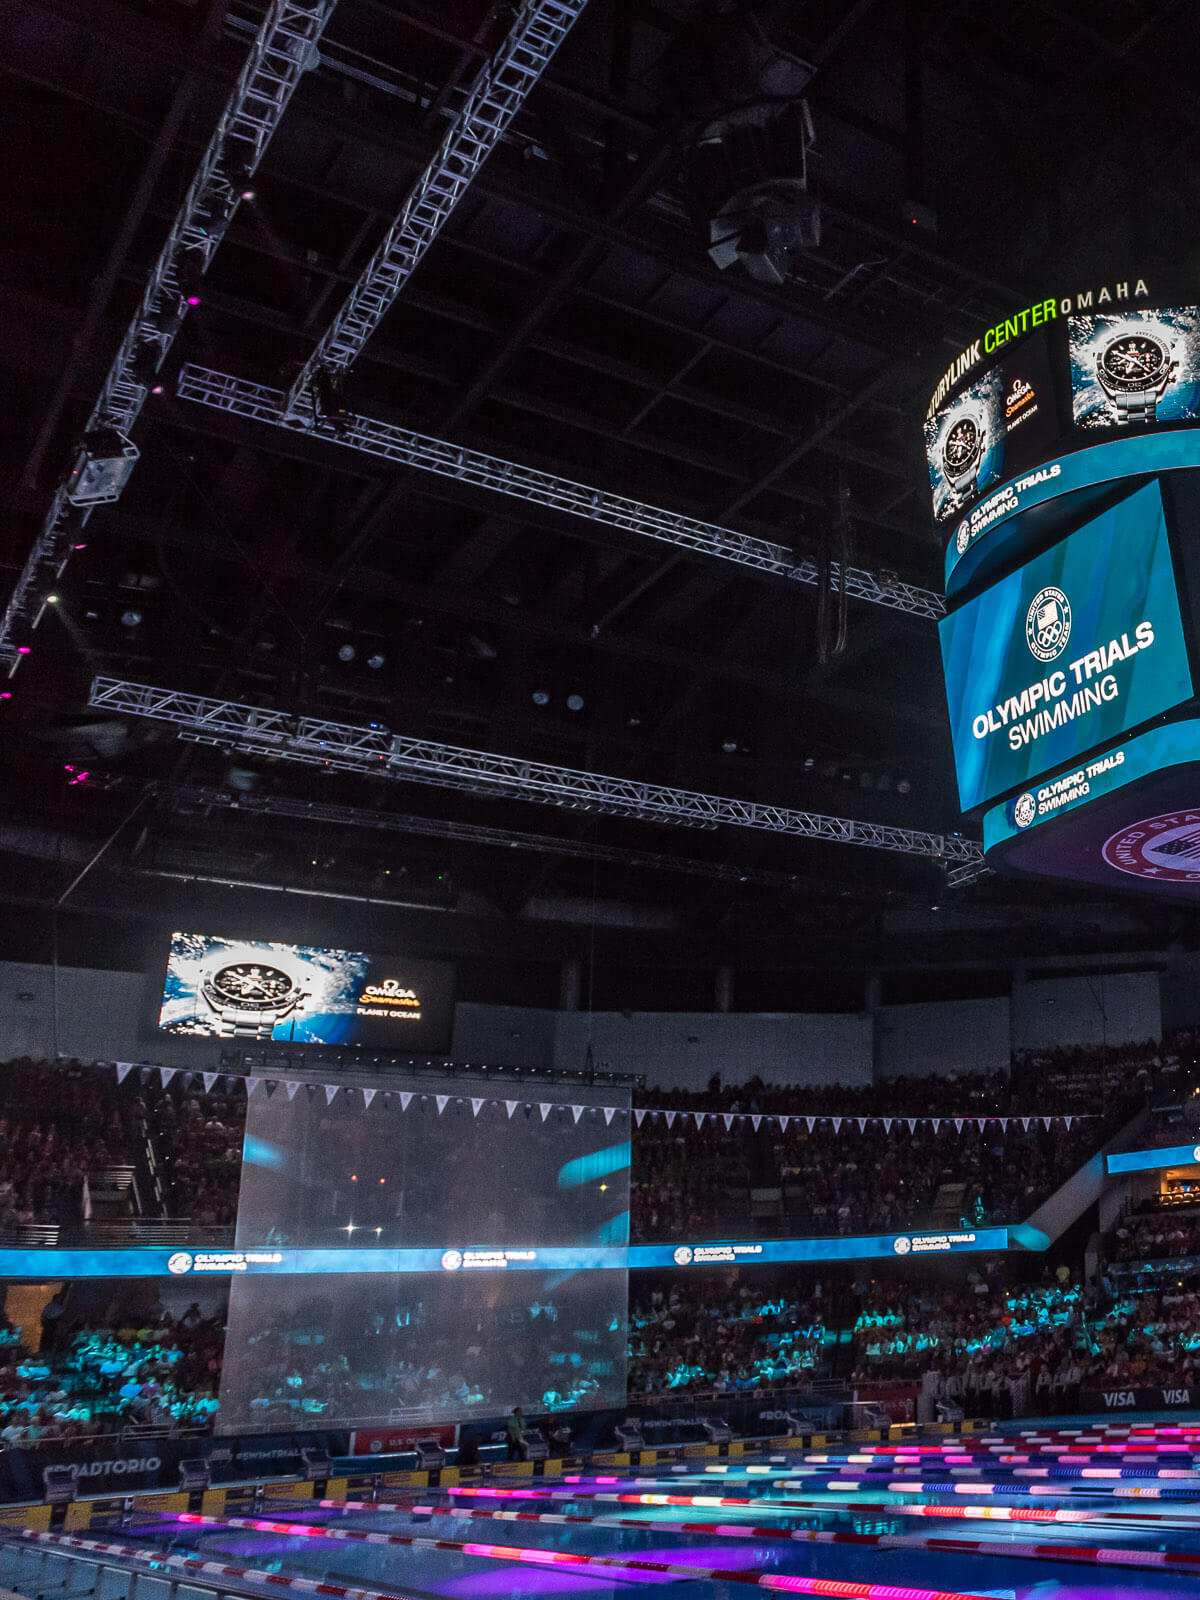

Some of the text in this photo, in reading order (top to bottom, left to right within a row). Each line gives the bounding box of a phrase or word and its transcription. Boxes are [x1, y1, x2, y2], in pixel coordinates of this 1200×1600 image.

[984, 298, 1057, 353] CENTER
[1061, 279, 1149, 314] OMAHA
[1007, 382, 1031, 405] OMEGA
[970, 464, 1062, 525] OLYMPIC TRIALS
[970, 497, 1019, 537] SWIMMING
[972, 621, 1155, 739] OLYMPIC TRIALS
[1009, 674, 1119, 750] SWIMMING
[1038, 751, 1125, 801] OLYMPIC TRIALS
[1038, 782, 1090, 815] SWIMMING
[1115, 831, 1146, 866] UNITED
[365, 986, 416, 999] OMEGA
[356, 1008, 421, 1020] PLANET OCEAN
[1102, 1391, 1136, 1407] VISA
[1161, 1389, 1190, 1404] VISA
